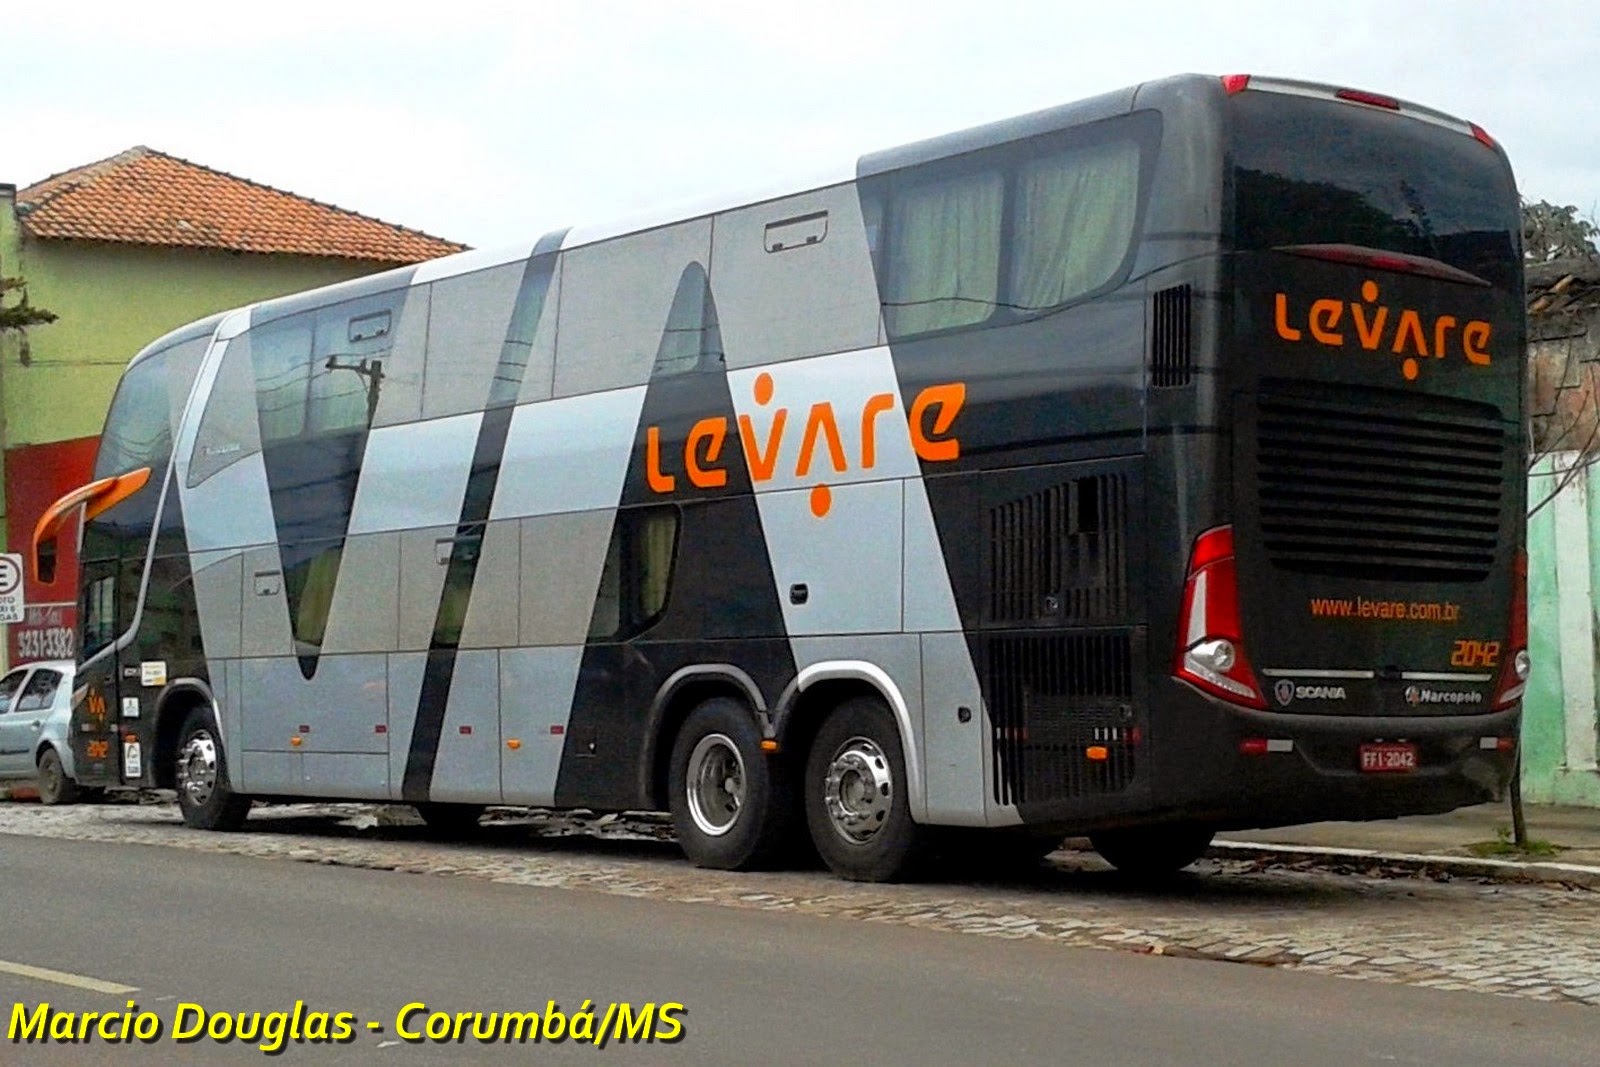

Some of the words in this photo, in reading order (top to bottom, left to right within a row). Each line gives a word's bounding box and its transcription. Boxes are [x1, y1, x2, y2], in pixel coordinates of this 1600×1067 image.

[1311, 596, 1459, 620] www.levare.com.br
[1451, 640, 1500, 666] 2042
[1296, 686, 1346, 699] SCANIA
[1421, 689, 1482, 704] Marcopolo
